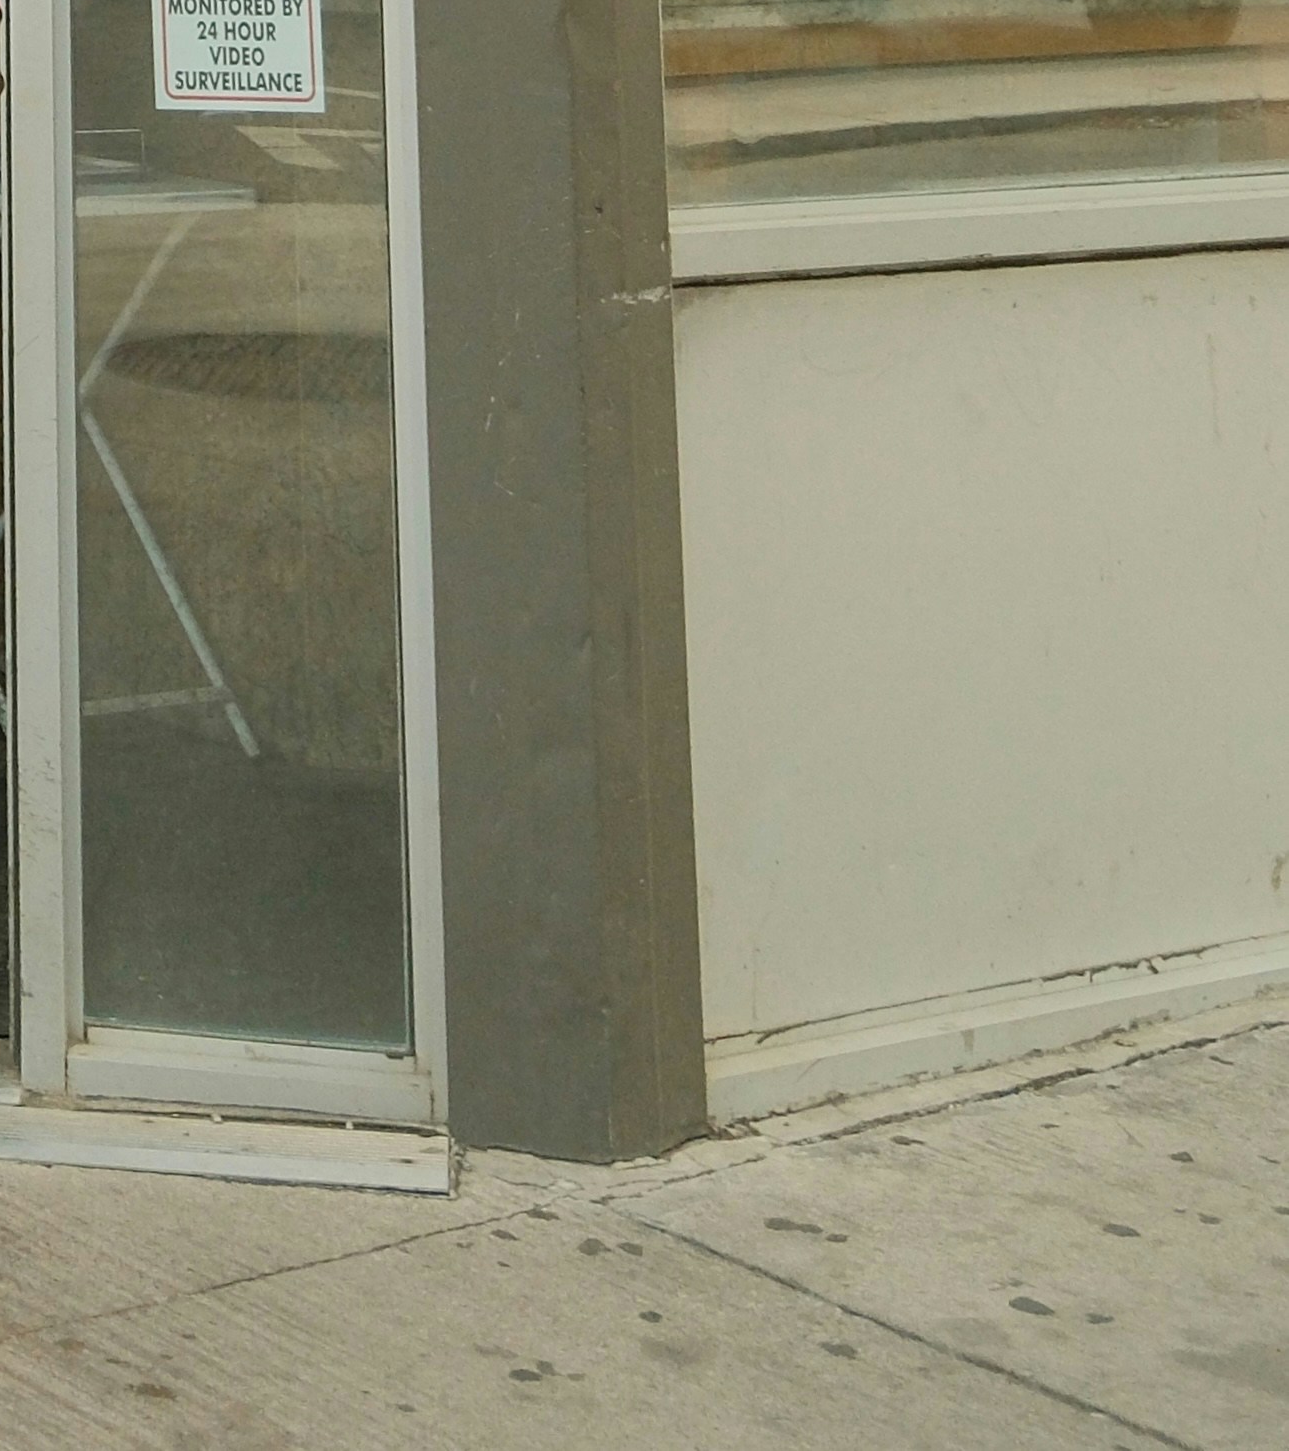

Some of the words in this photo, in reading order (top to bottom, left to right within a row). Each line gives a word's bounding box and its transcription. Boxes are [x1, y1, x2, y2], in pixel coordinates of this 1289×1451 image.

[197, 21, 218, 41] 24
[225, 22, 277, 42] HOUR
[209, 46, 265, 66] VIDEO
[175, 70, 303, 92] SURVEILLANCE
